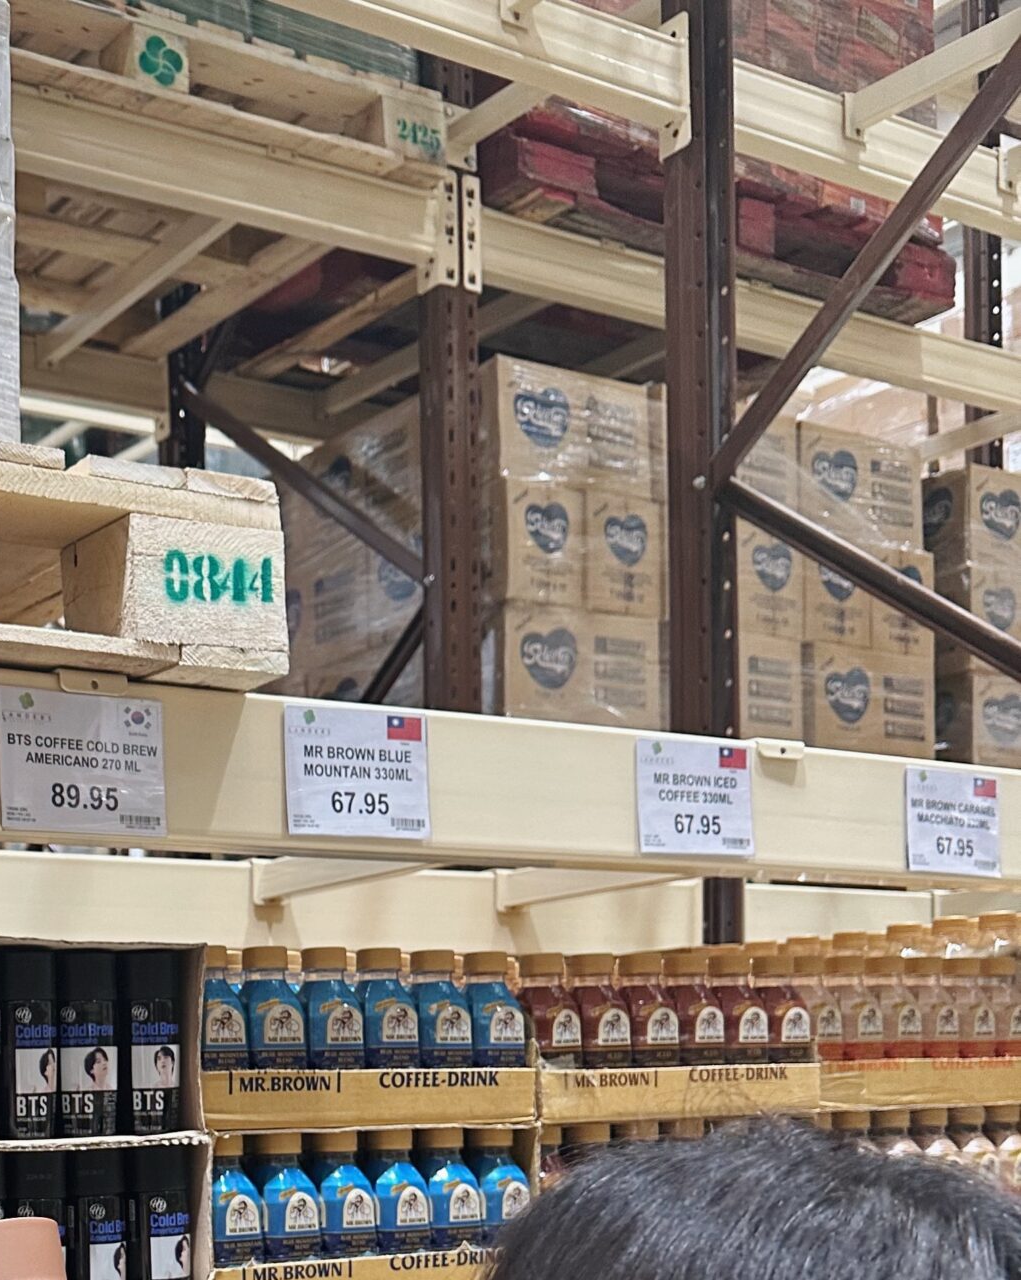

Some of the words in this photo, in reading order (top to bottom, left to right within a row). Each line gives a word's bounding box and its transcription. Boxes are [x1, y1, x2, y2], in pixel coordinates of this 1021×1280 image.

[165, 550, 274, 602] 0844
[7, 733, 31, 746] BTS
[35, 736, 83, 750] COFFEE
[87, 740, 119, 754] COLD
[123, 744, 158, 757] BREW
[304, 745, 323, 758] MR
[327, 746, 375, 761] BROWN
[379, 750, 412, 763] BLUE
[26, 752, 98, 768] AMERICANO
[102, 758, 121, 770] 270
[124, 760, 141, 772] ML
[304, 764, 371, 779] MOUNTAIN
[375, 768, 413, 781] 330ML
[653, 772, 670, 784] MR
[673, 774, 711, 787] BROWN
[714, 777, 737, 789] ICED
[51, 783, 119, 811] 89.95
[331, 792, 389, 815] 67.95
[658, 789, 699, 803] COFFEE
[674, 814, 721, 834] 67.95
[936, 836, 974, 857] 67.95
[379, 1071, 499, 1089] COFFEE-DRINK
[16, 1096, 47, 1117] BTS
[150, 1212, 176, 1227] Cold
